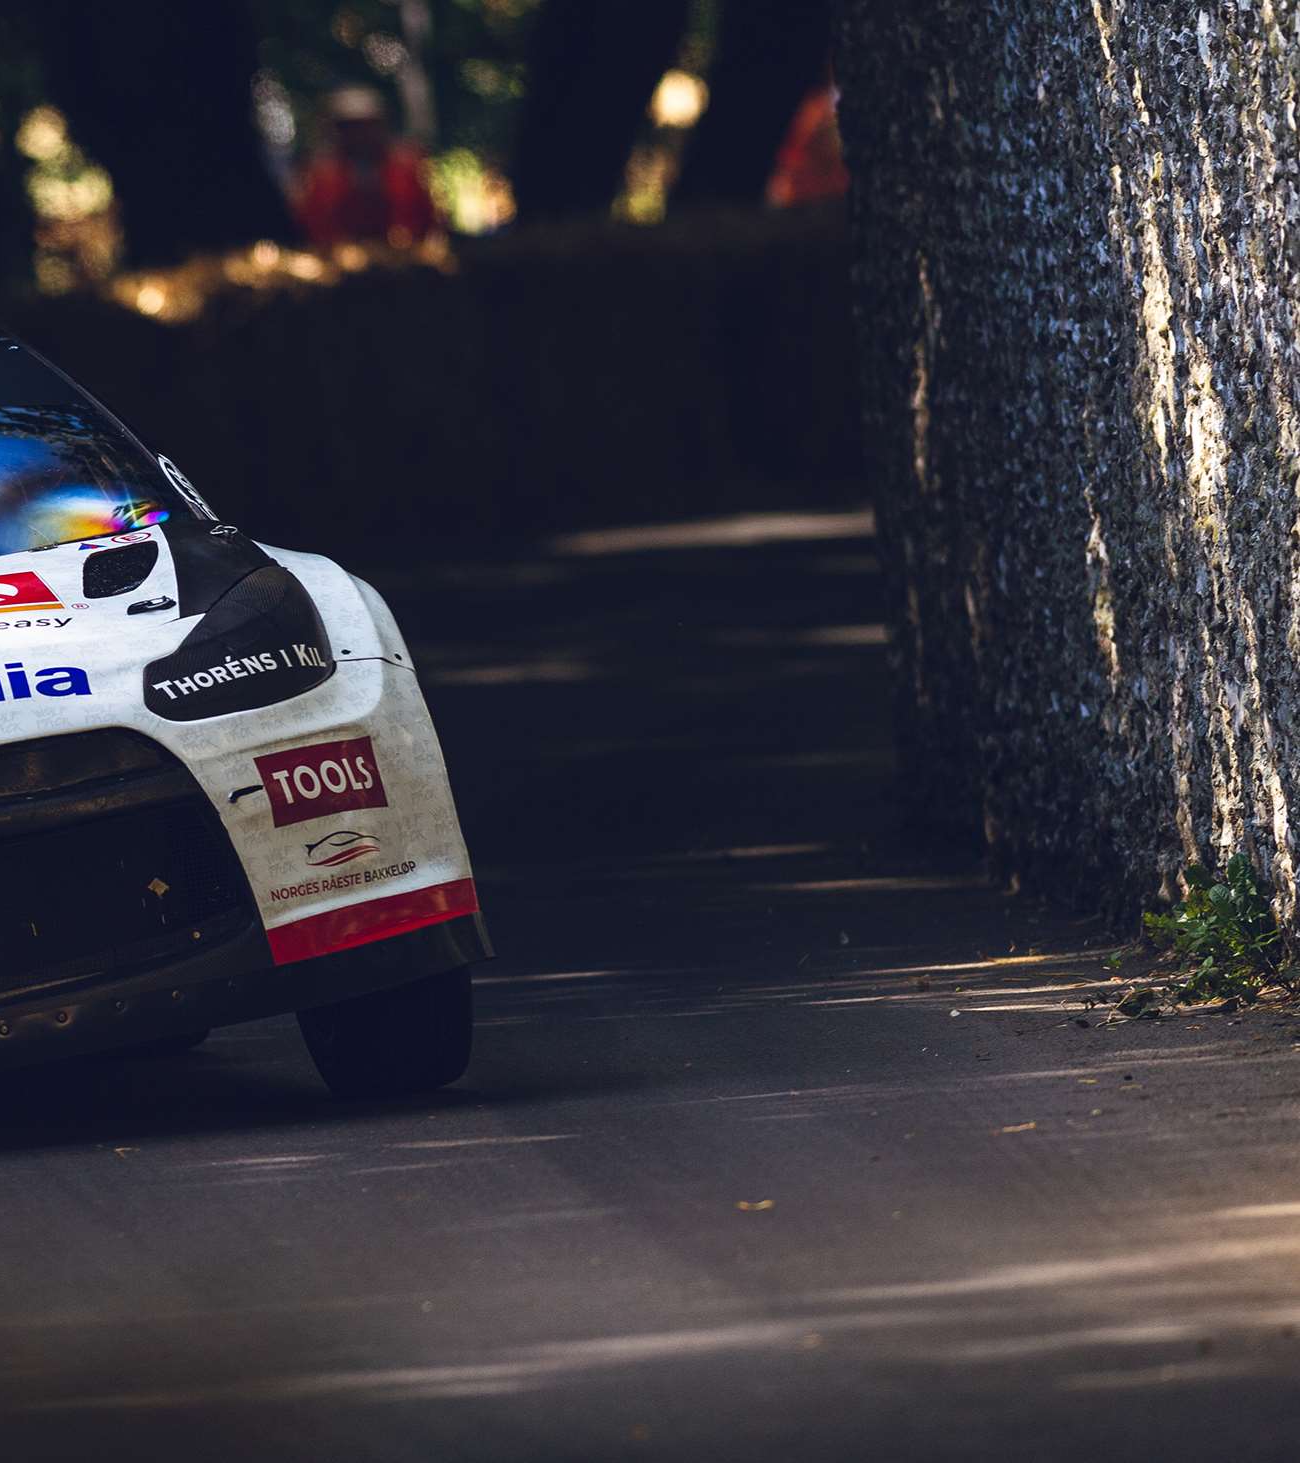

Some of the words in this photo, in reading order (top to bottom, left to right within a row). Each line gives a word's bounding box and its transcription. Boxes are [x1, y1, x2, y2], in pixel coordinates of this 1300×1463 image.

[271, 755, 375, 805] TOOLS
[270, 882, 320, 902] NORGES
[322, 872, 362, 893] RÅESTE
[363, 860, 417, 883] BAKKELØP
